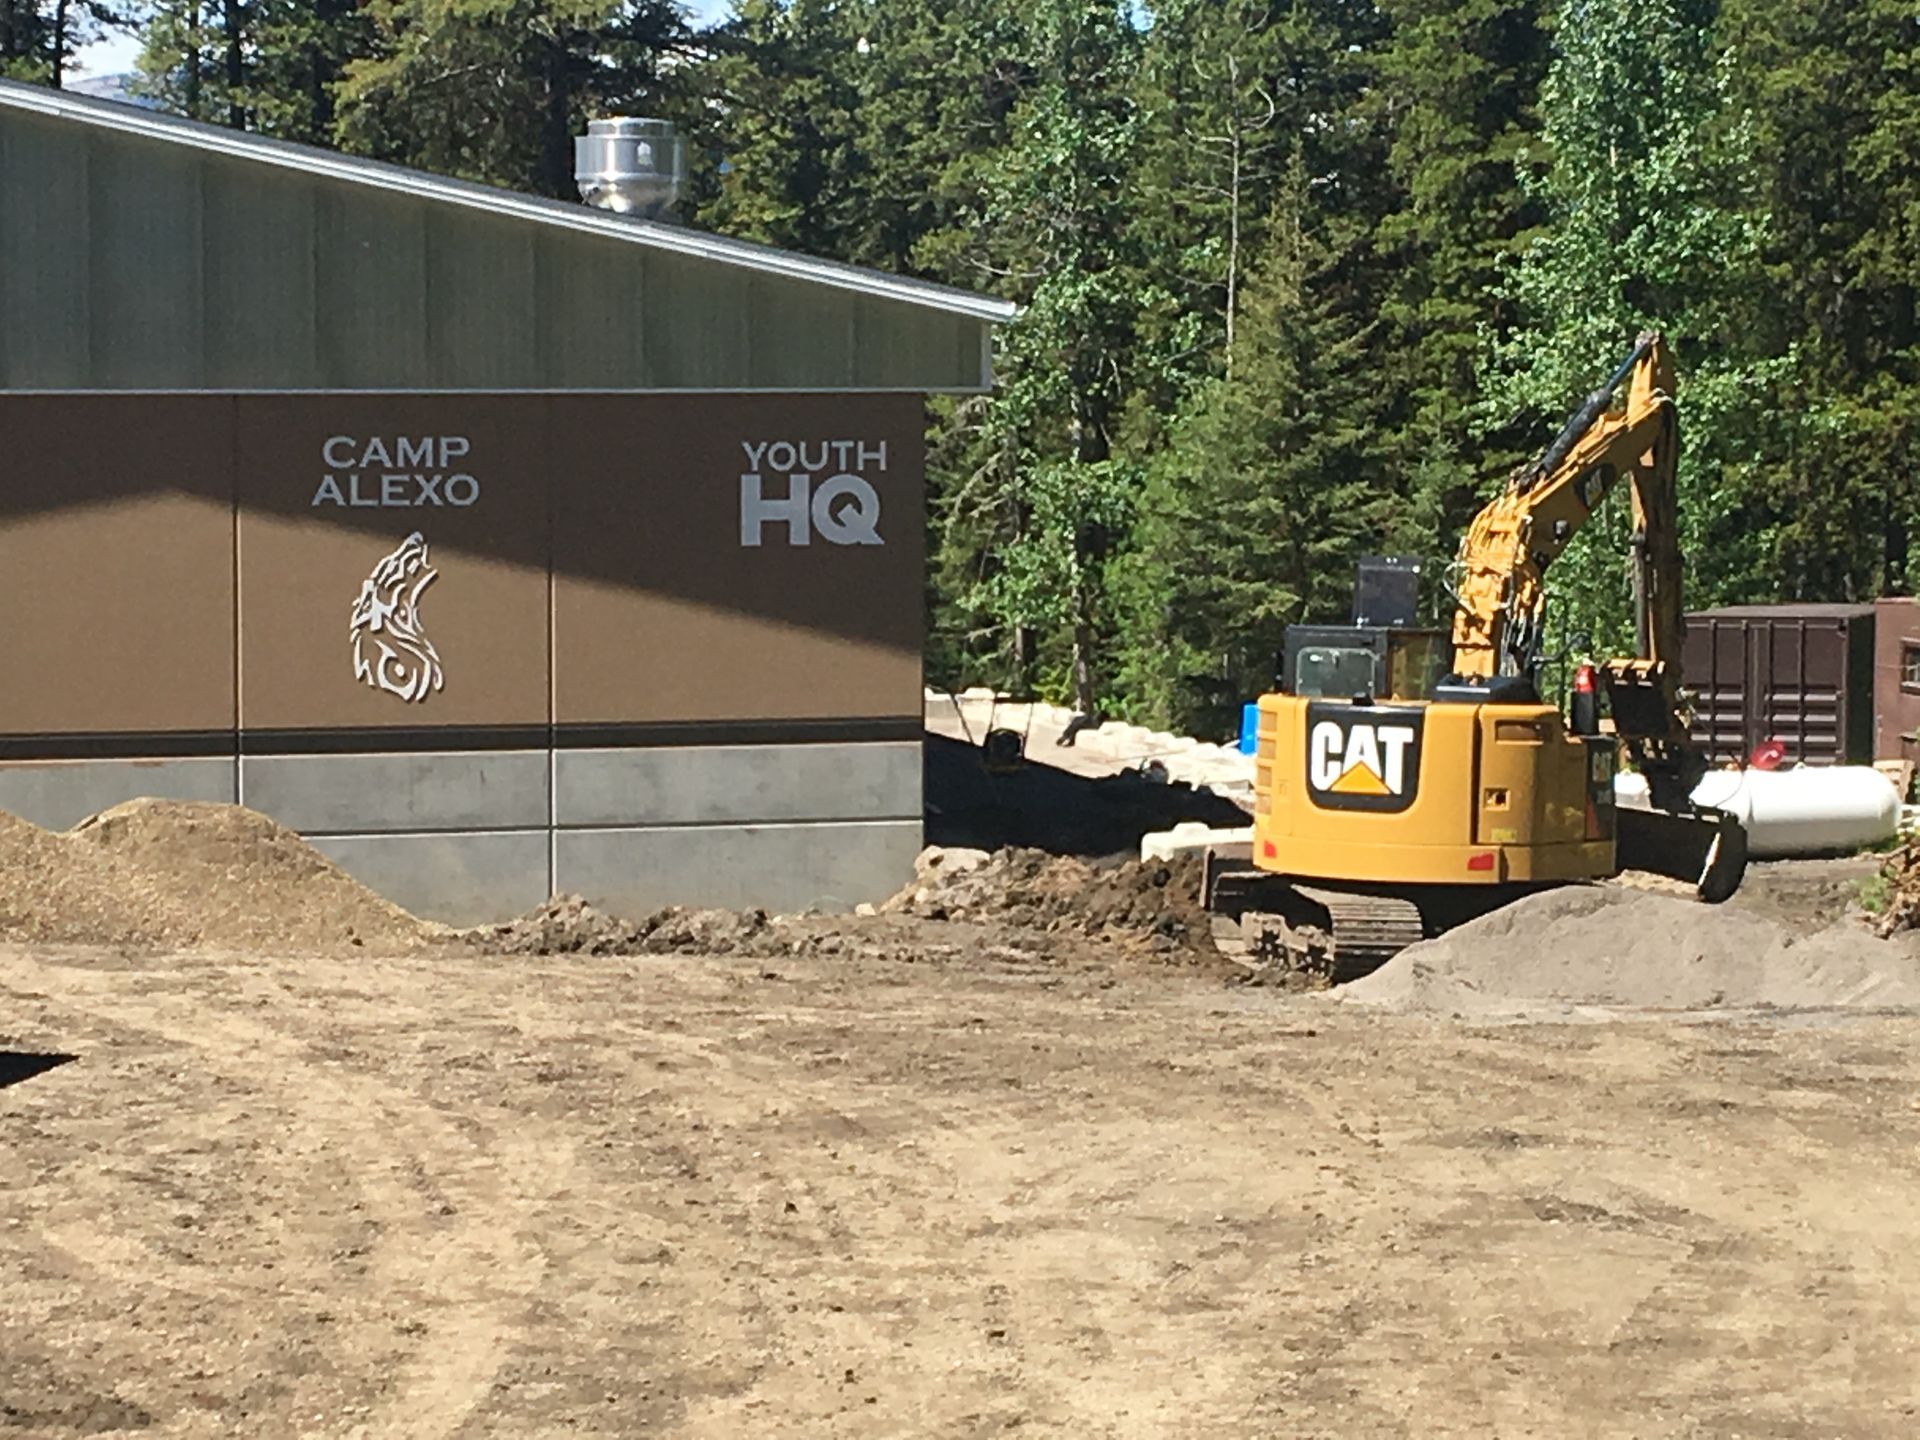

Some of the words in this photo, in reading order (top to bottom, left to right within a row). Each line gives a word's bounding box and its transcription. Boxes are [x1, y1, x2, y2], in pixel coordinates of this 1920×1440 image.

[322, 436, 470, 468] CAMP
[741, 440, 887, 472] YOUTH
[312, 474, 480, 506] ALEXO
[740, 474, 885, 546] HQ
[1310, 721, 1414, 795] CAT
